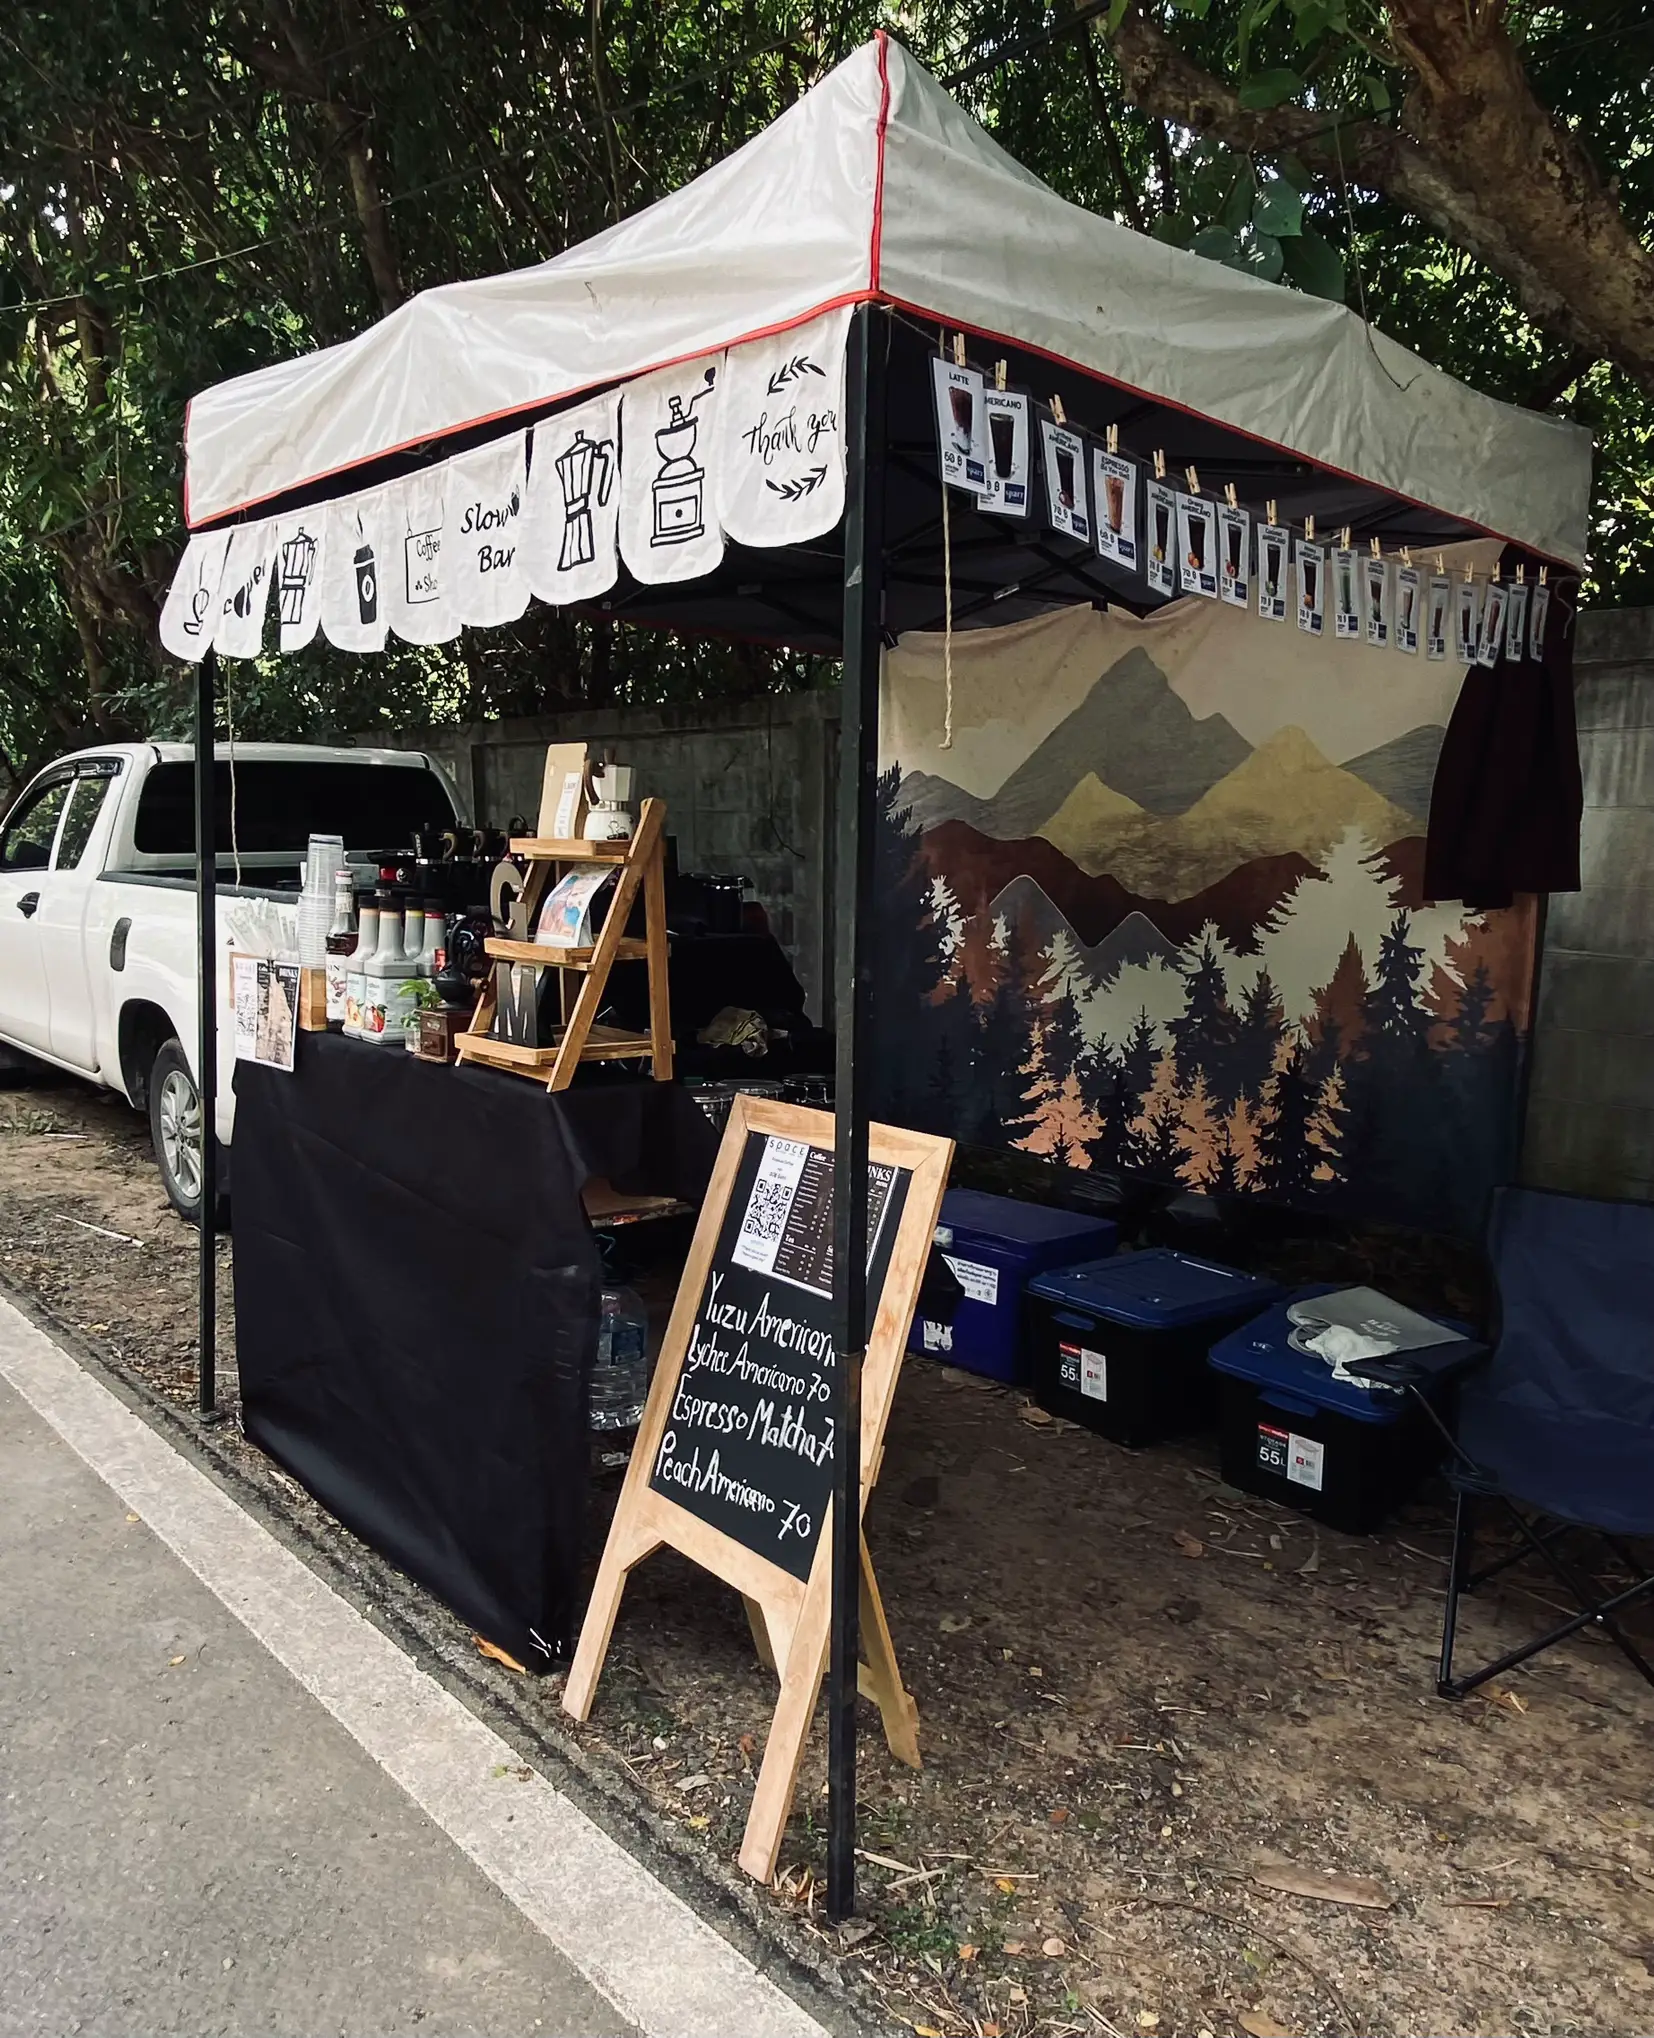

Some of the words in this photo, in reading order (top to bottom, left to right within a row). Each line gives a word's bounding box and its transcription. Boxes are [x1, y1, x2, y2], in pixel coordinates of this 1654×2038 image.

[949, 372, 969, 385] LATTE
[984, 396, 1021, 410] MERICANO
[477, 545, 515, 573] Bar
[705, 1270, 748, 1335] Yuzu
[688, 1323, 729, 1373] Lychee
[725, 1340, 806, 1396] Americano
[806, 1372, 831, 1402] 70
[672, 1373, 749, 1434] Espresso
[746, 1398, 816, 1464] Matcha
[817, 1416, 835, 1467] 7
[655, 1430, 702, 1493] Peach
[777, 1499, 811, 1541] 70
